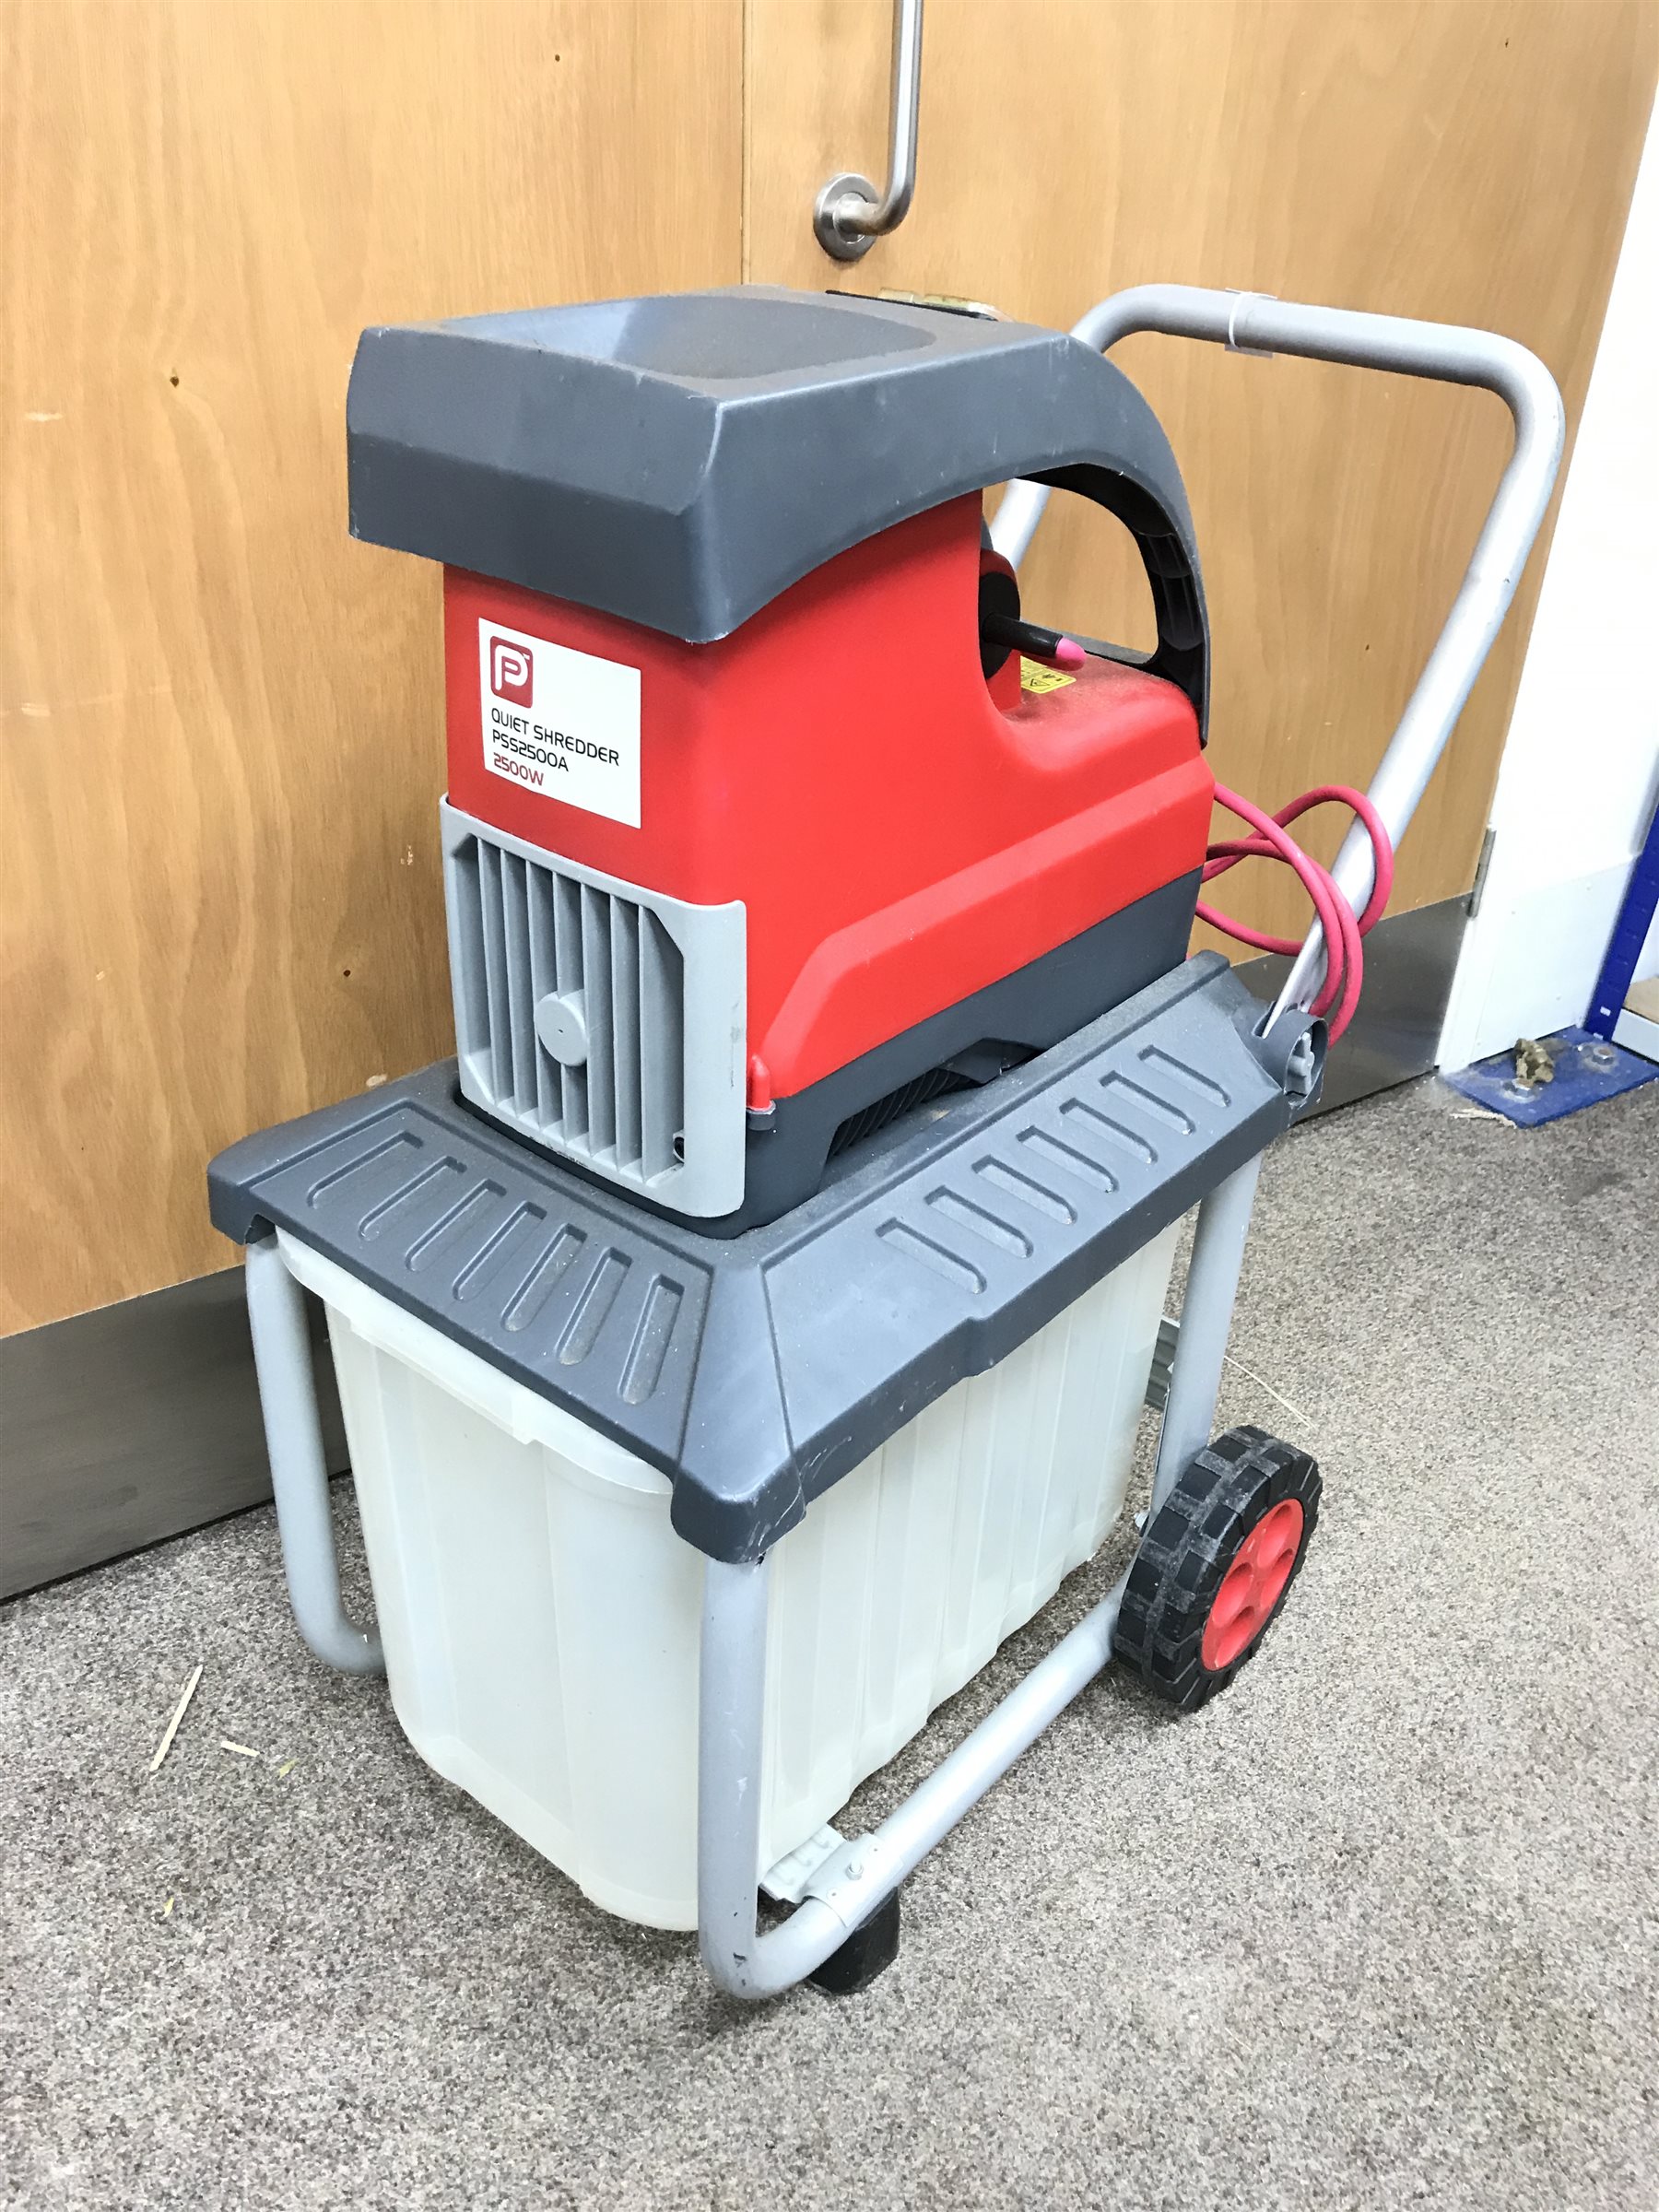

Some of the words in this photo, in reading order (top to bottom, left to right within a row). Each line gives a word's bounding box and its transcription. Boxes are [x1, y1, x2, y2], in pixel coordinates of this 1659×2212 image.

[491, 708, 529, 735] QUIET
[534, 725, 619, 766] SHREDDER
[492, 729, 569, 771] PSS2500A
[493, 752, 544, 785] 2500W
